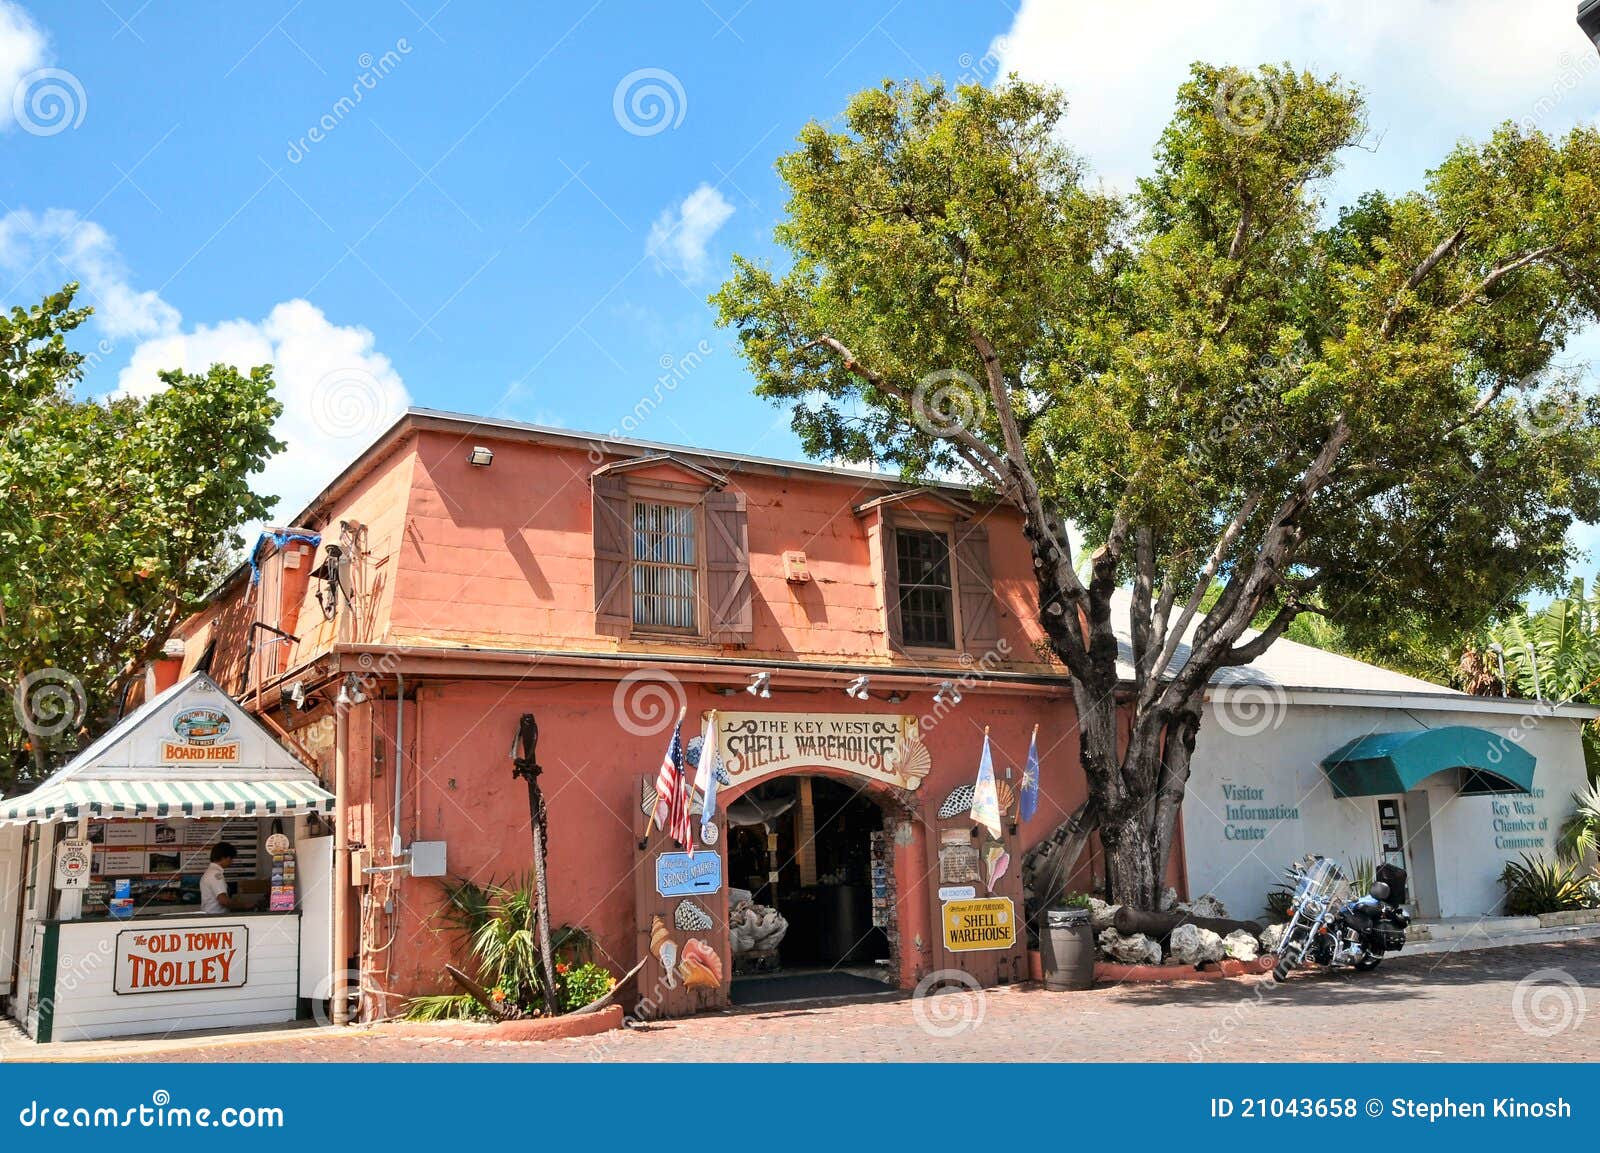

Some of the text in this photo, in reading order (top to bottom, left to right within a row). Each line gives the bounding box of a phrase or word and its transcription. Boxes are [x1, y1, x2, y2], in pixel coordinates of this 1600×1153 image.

[759, 720, 871, 734] THE KEY WEST
[165, 743, 237, 760] BOARD HERE
[726, 734, 897, 776] SHELL WAREHOUSE
[1222, 783, 1265, 801] Visitor
[1226, 804, 1300, 821] Information
[1491, 800, 1536, 818] Key West
[1224, 824, 1267, 841] Center
[1492, 816, 1549, 832] Chamber of
[1494, 835, 1545, 849] Commerce
[66, 877, 78, 886] #1
[963, 913, 997, 928] SHELL
[133, 931, 233, 953] The OLD TOWN
[950, 926, 1011, 943] WAREHOUSE
[127, 948, 237, 988] TROLLEY
